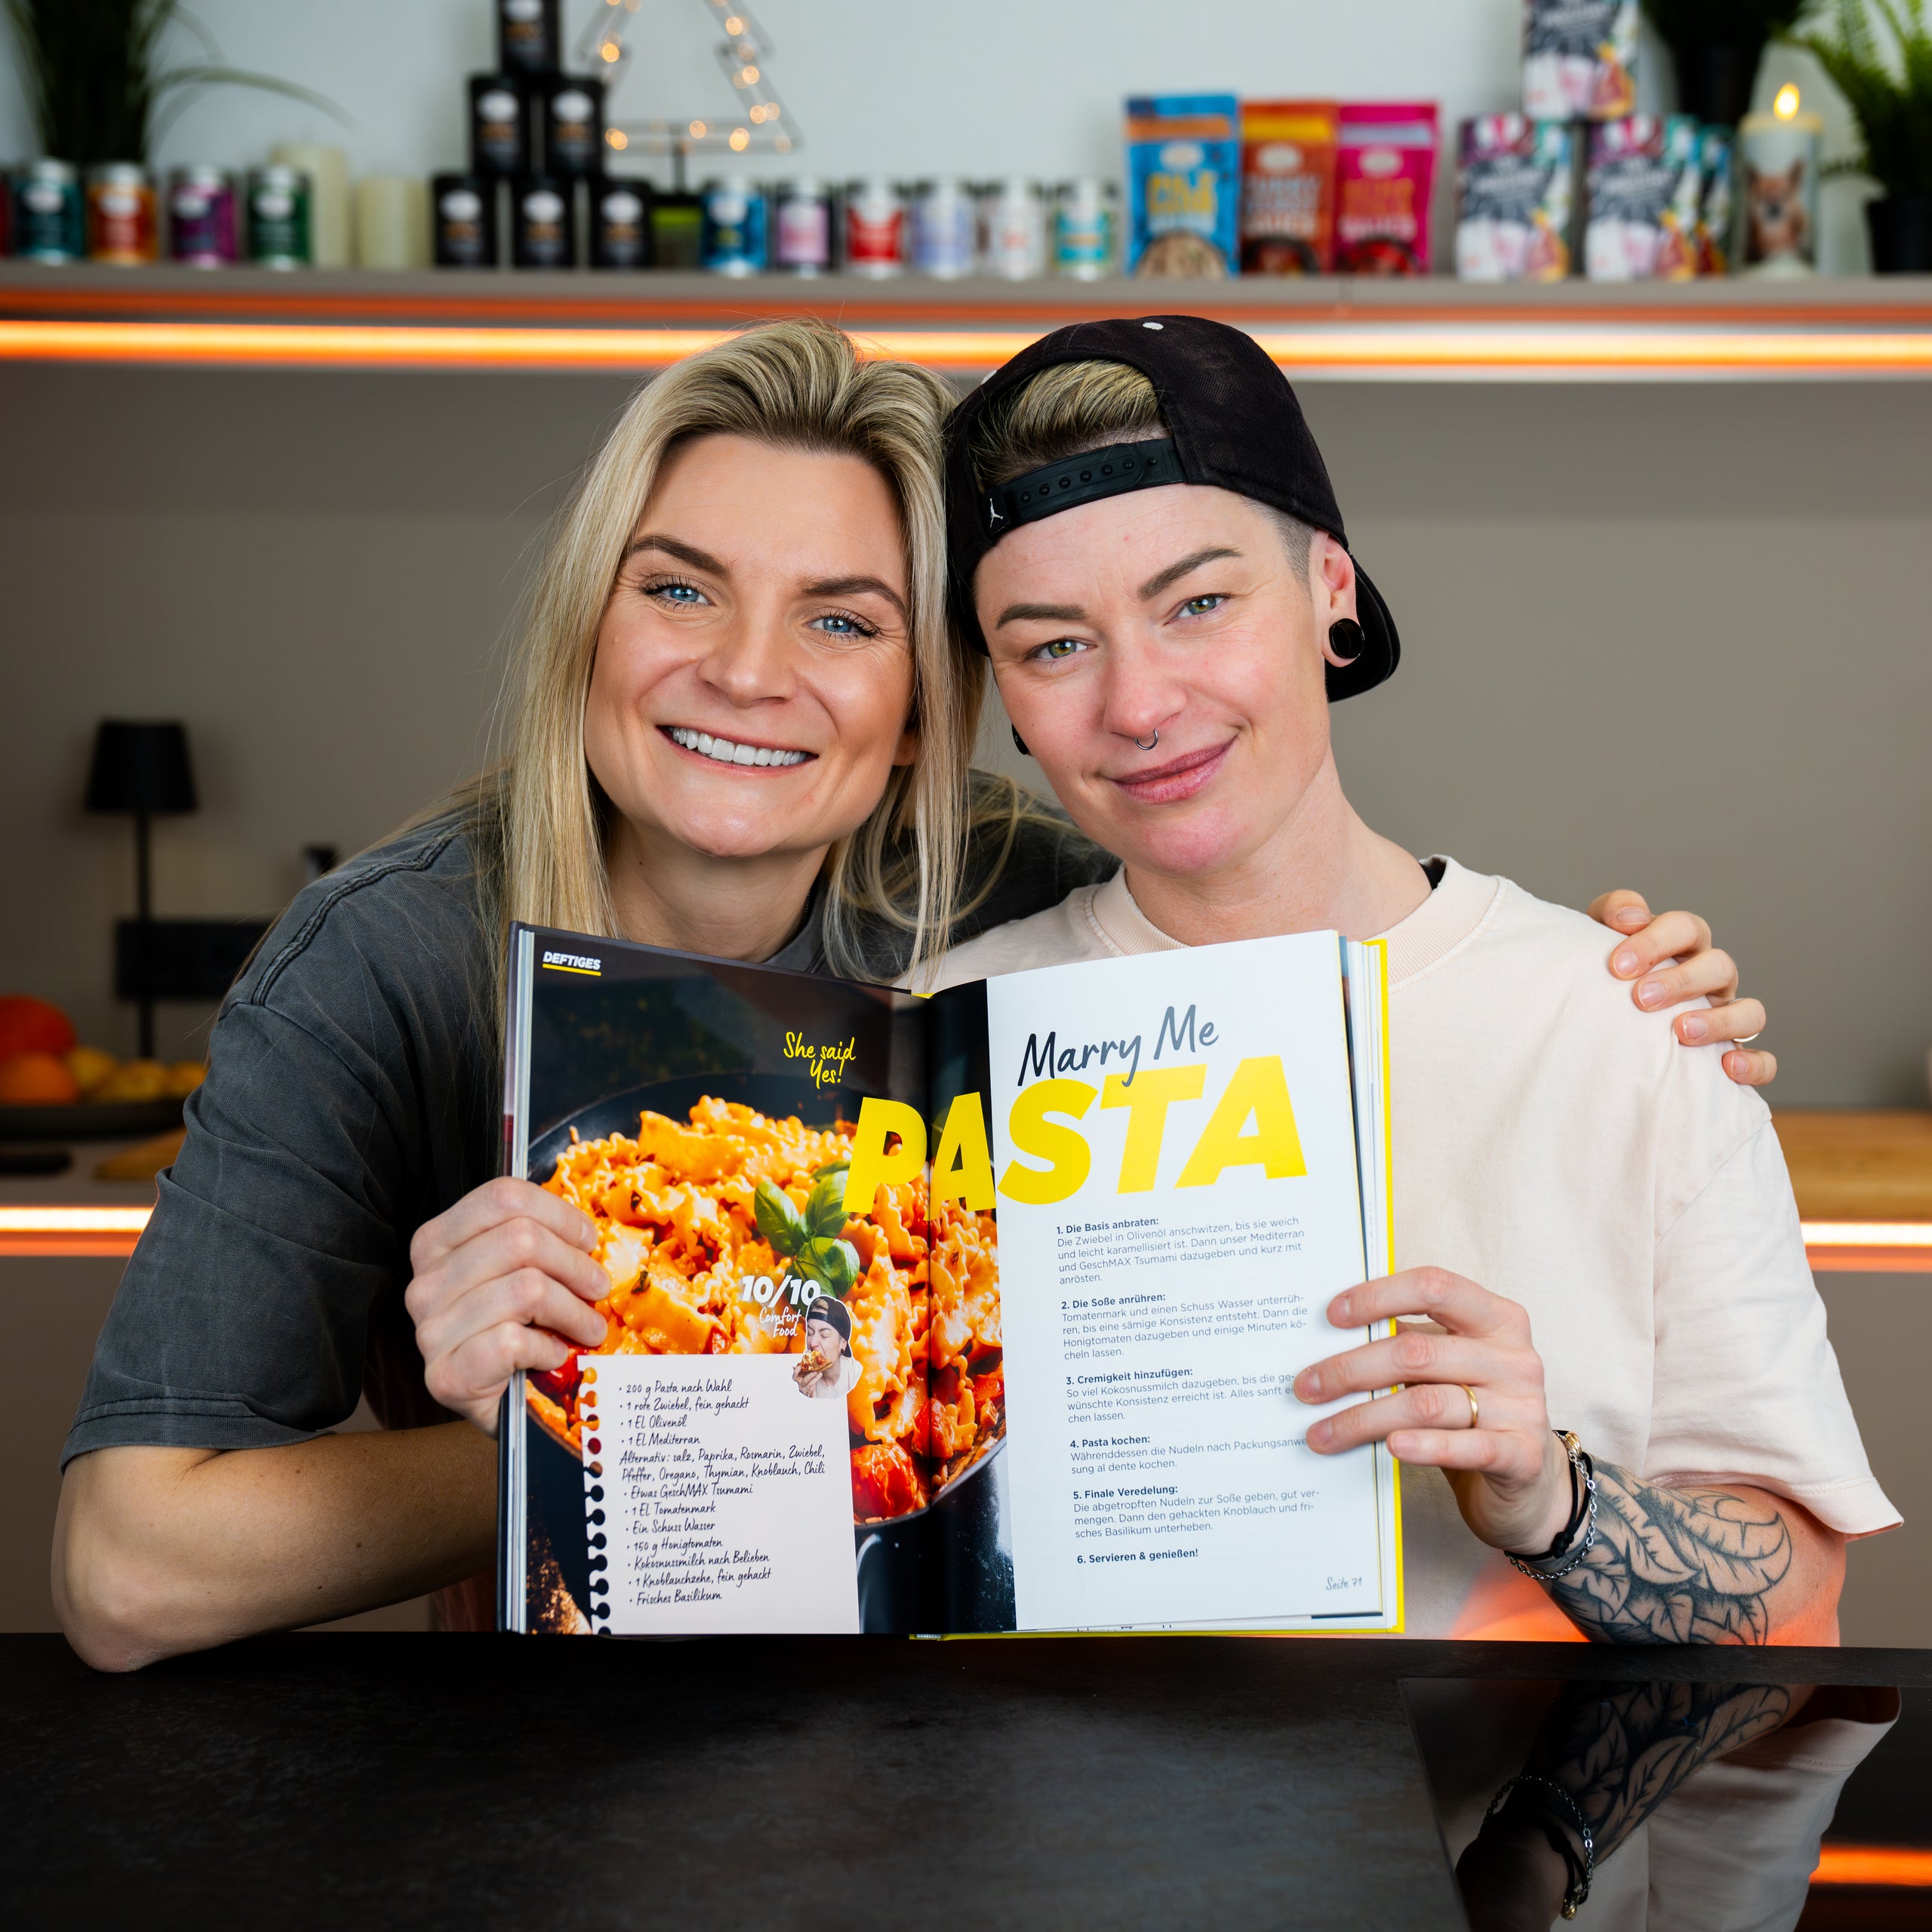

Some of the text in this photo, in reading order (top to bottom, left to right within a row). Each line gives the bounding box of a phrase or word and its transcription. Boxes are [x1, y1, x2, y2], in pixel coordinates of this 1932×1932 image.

[543, 951, 601, 971] DEFTIGES
[783, 1031, 856, 1060] She said
[1017, 1004, 1220, 1088] Marry Me
[810, 1058, 845, 1090] Yes!
[841, 1055, 1308, 1221] PASTA
[1056, 1217, 1158, 1234] 1. Die Basis anbraten:
[1057, 1216, 1299, 1247] Die Zwiebel Olivenöl anschwitzen, bis sie weich
[1057, 1230, 1304, 1260] und leicht karamellisiert ist. Dann unser Mediterran
[1058, 1242, 1302, 1272] und GeschMAX Tsumami dazugeben und kurz mit
[1059, 1274, 1103, 1284] anrösten.
[741, 1275, 821, 1308] 10/10
[1061, 1294, 1165, 1309] 2. Die Soße anrühren:
[1061, 1293, 1304, 1321] Tomatenmark und einen Schuss Wasser unterrüh-
[759, 1306, 802, 1325] Comfort
[1082, 1306, 1308, 1333] bis eine sämige Konsistenz entsteht. Dann die
[773, 1321, 798, 1337] Food
[1063, 1321, 1287, 1347] Honigtomaten dazugeben und einige Minuten
[1063, 1348, 1124, 1360] cheln lassen.
[626, 1378, 733, 1393] 200 Pasta nach Wahl
[1066, 1368, 1193, 1385] 3. Cremigkeit hinzufügen:
[1066, 1389, 1079, 1398] So
[1081, 1386, 1098, 1396] viel
[1100, 1380, 1179, 1395] Kokosnussmilch
[1181, 1377, 1239, 1389] dazugeben,
[1241, 1375, 1257, 1384] bis
[1259, 1374, 1275, 1383] die
[634, 1395, 749, 1416] rote Zwiebel, fein gehackt
[1067, 1386, 1281, 1410] wünschte Konsistenz erreicht ist. Alles sanft
[648, 1414, 688, 1428] Olivenöl
[1067, 1412, 1126, 1423] chen lassen.
[648, 1432, 700, 1446] Mediterran
[1069, 1435, 1150, 1448] 4. Pasta kochen:
[618, 1444, 825, 1466] Alternativ: Paprika, Rosmarin, Zwiebel,
[1070, 1438, 1307, 1461] Währenddessen die Nudeln nach Packungsanwe
[621, 1460, 825, 1485] Pfeffer, Oregano, Thymian, Knoblauch, Chili
[1070, 1459, 1177, 1475] sung dente kochen.
[630, 1482, 753, 1499] Etwas GeschMAX Tsumami
[1072, 1485, 1178, 1500] 5. Finale Veredelung:
[654, 1500, 716, 1515] Tomatenmark
[1073, 1503, 1090, 1512] Die
[1092, 1499, 1157, 1512] abgetropften
[1159, 1496, 1195, 1506] Nudeln
[1216, 1493, 1241, 1503] Soße
[1244, 1491, 1278, 1503] geben,
[1280, 1490, 1297, 1501] gut
[1074, 1503, 1297, 1525] mengen. Dann den gehackten Knoblauch und
[632, 1518, 715, 1534] Ein Schuss Wasser
[1075, 1521, 1214, 1538] sches Basilikum unterheben.
[633, 1536, 723, 1555] 150 Honigtomaten
[633, 1549, 770, 1570] Kokosnussmilch nach Belieben
[1076, 1548, 1198, 1564] 6. Servieren genießen!
[642, 1566, 771, 1587] Knoblauchzehe, fein gehackt
[1326, 1576, 1348, 1590] Seite
[636, 1587, 722, 1605] Frisches Basilikum
